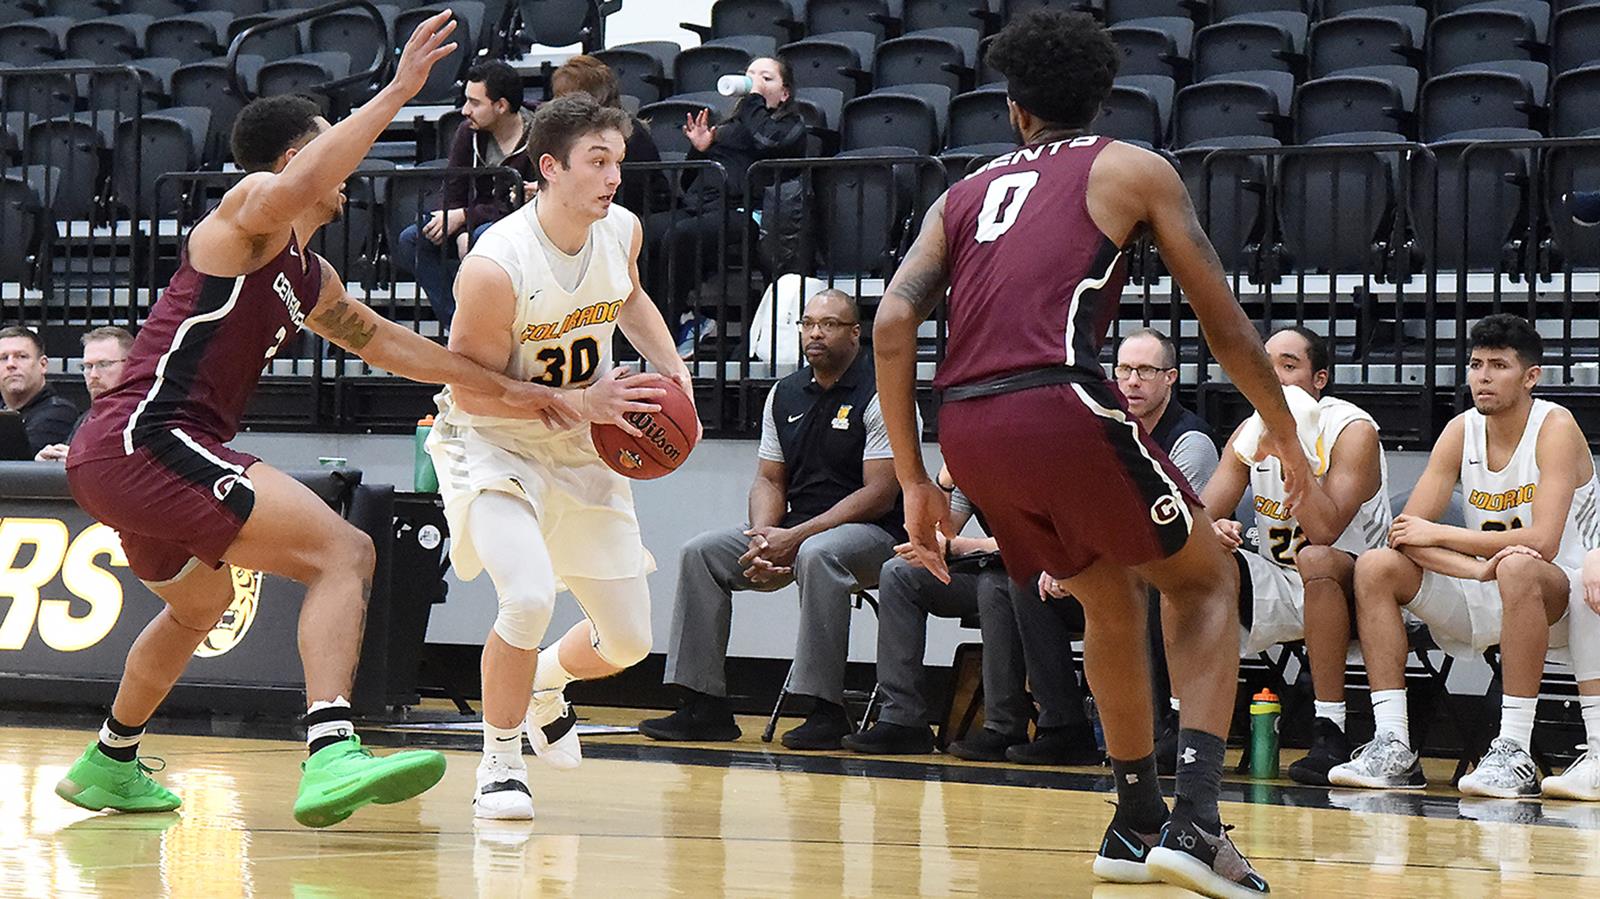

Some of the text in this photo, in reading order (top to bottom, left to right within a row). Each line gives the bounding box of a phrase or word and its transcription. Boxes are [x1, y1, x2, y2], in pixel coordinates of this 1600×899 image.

[974, 170, 1040, 244] 0
[520, 299, 624, 345] COLRADO
[530, 335, 599, 388] 30
[627, 412, 681, 462] Wilson
[1468, 483, 1537, 512] COLORO
